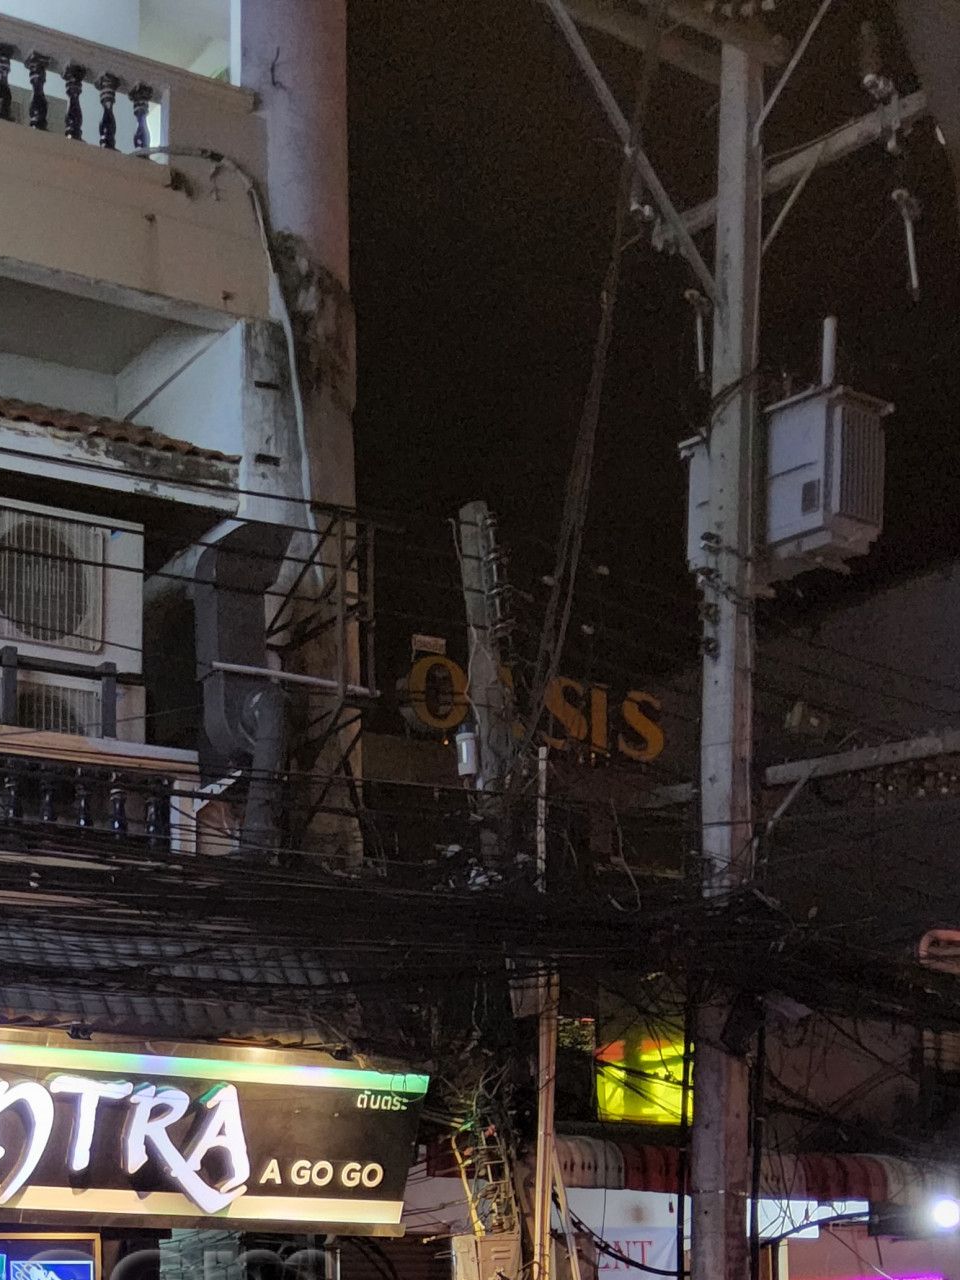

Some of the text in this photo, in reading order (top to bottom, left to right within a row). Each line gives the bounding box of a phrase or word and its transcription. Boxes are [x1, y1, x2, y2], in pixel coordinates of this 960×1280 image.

[408, 655, 665, 762] OSIS
[259, 1159, 384, 1188] A GO GO
